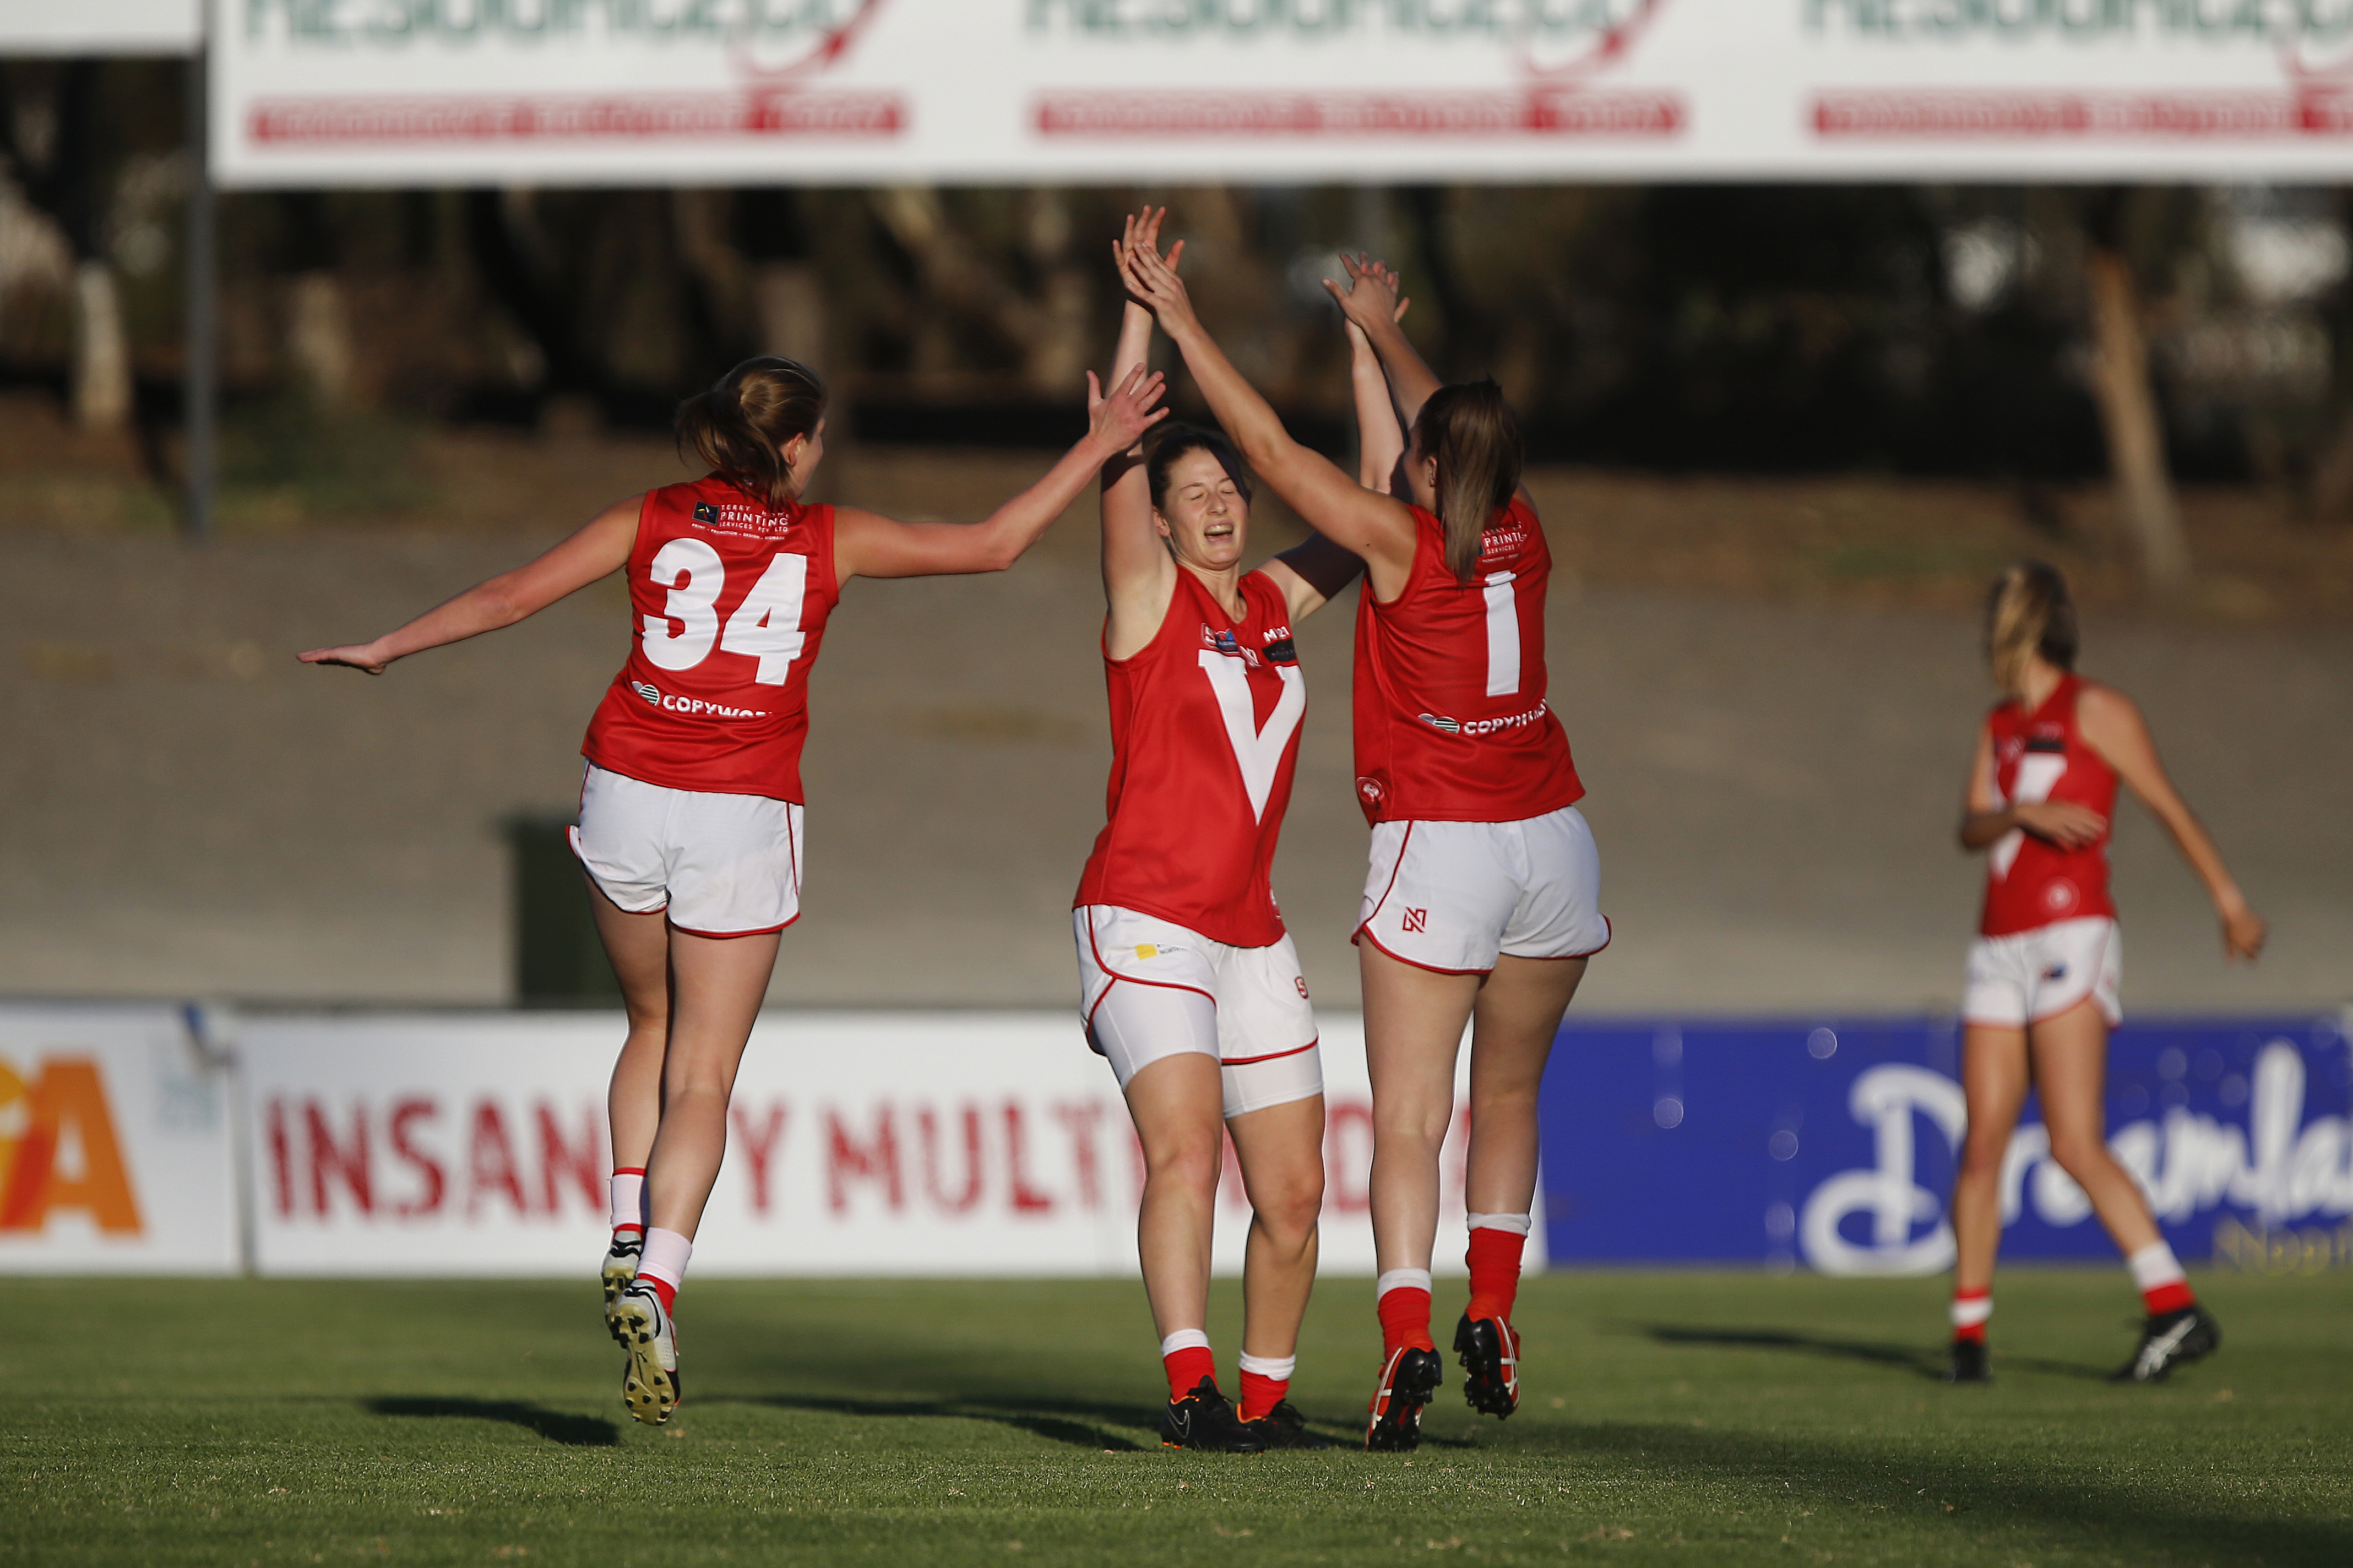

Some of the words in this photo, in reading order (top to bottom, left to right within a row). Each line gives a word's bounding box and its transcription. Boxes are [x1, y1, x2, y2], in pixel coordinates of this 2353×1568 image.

[719, 521, 753, 530] SERVICES
[720, 511, 789, 526] PRINTING
[642, 538, 807, 687] 34
[1483, 570, 1521, 696] 1
[269, 1098, 785, 1219] INSANY
